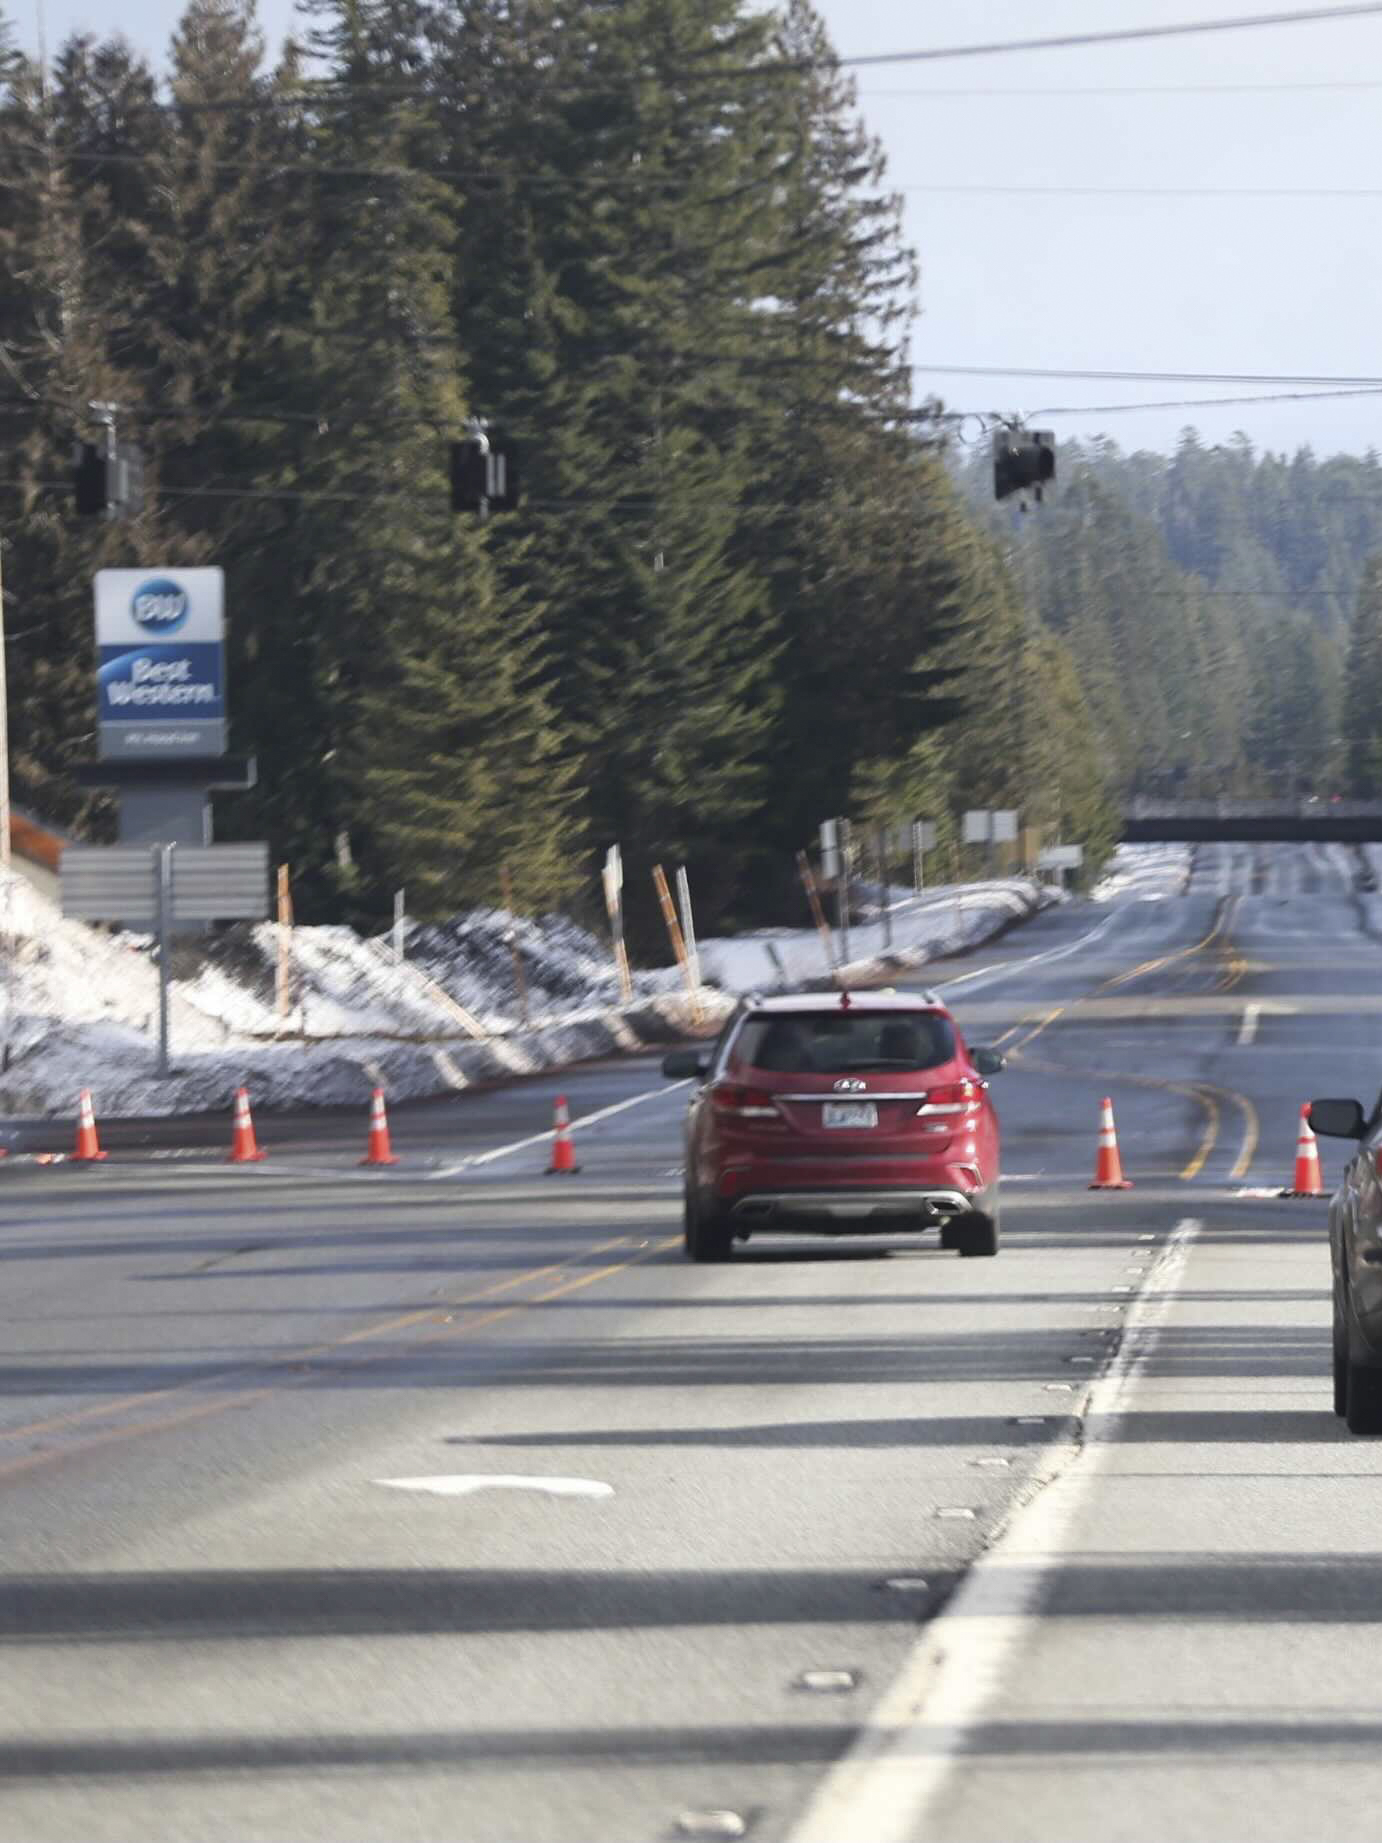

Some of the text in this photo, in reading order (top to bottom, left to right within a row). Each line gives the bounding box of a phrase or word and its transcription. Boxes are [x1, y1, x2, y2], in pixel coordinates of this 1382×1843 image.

[135, 593, 186, 622] BW
[132, 657, 192, 684] Best
[107, 681, 216, 706] Western
